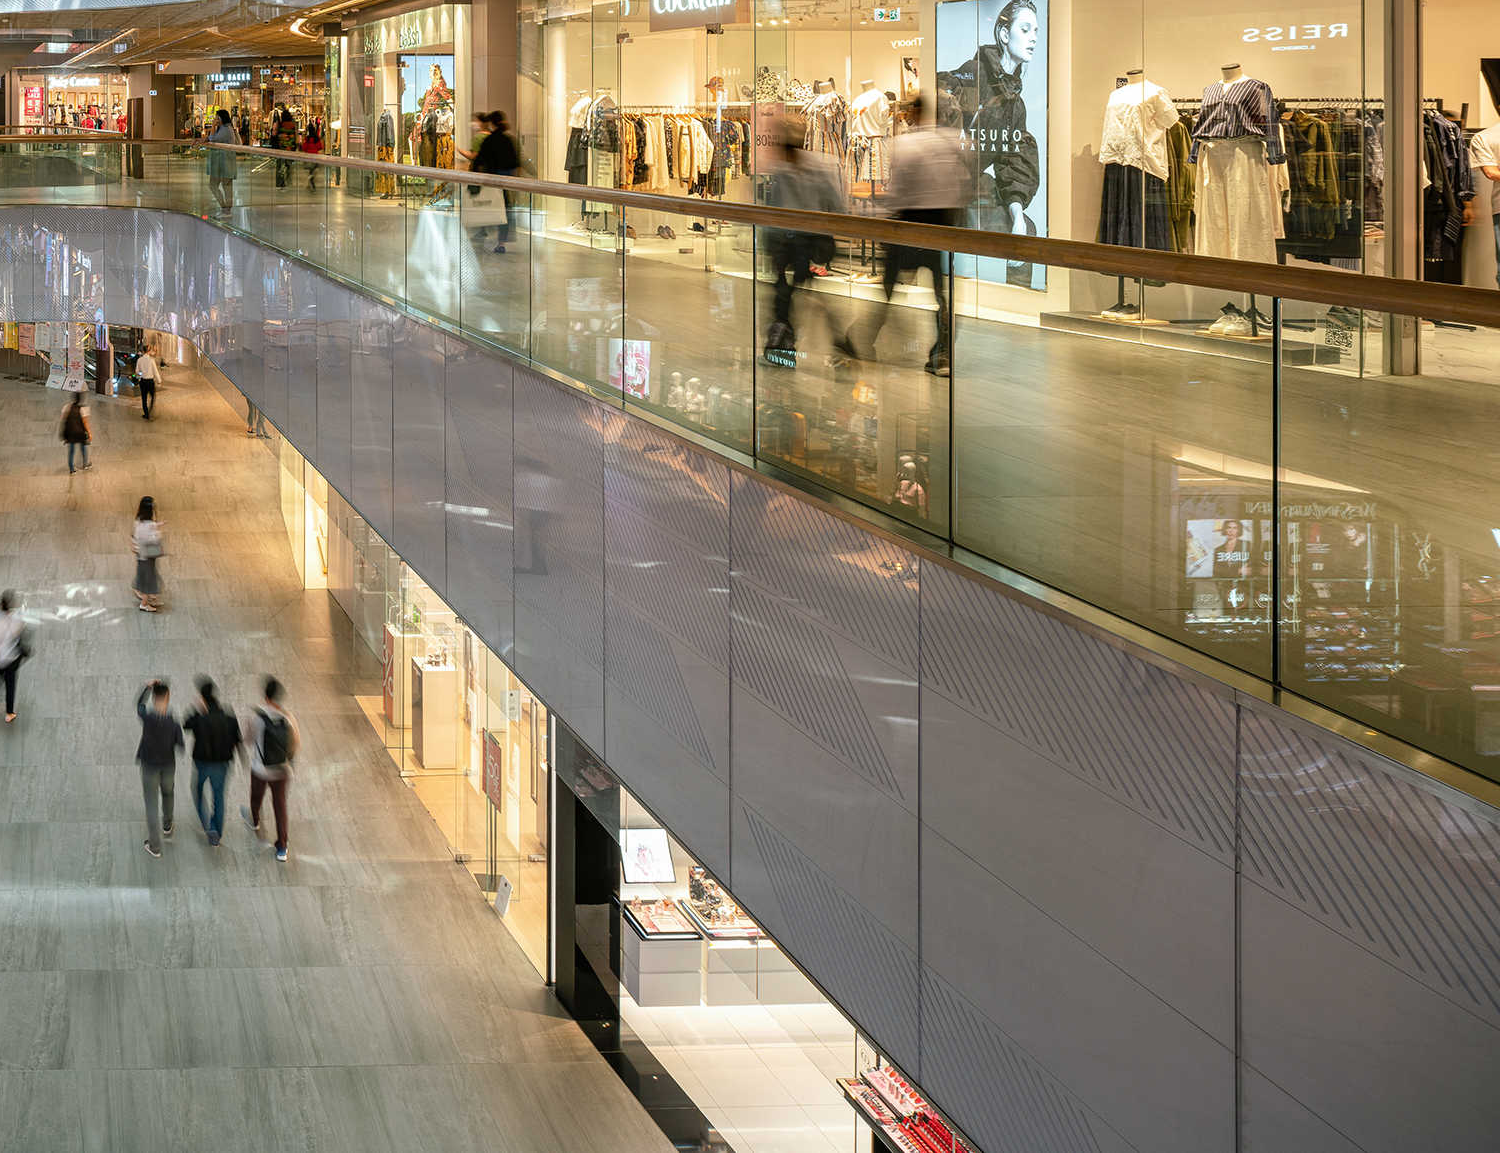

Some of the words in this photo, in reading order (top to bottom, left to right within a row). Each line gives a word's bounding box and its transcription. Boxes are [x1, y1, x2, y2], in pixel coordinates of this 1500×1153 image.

[227, 73, 251, 81] BAKER
[756, 134, 768, 147] 80
[959, 128, 1023, 142] ATSURO
[960, 142, 1021, 153] TAYAMA
[487, 754, 500, 781] 50
